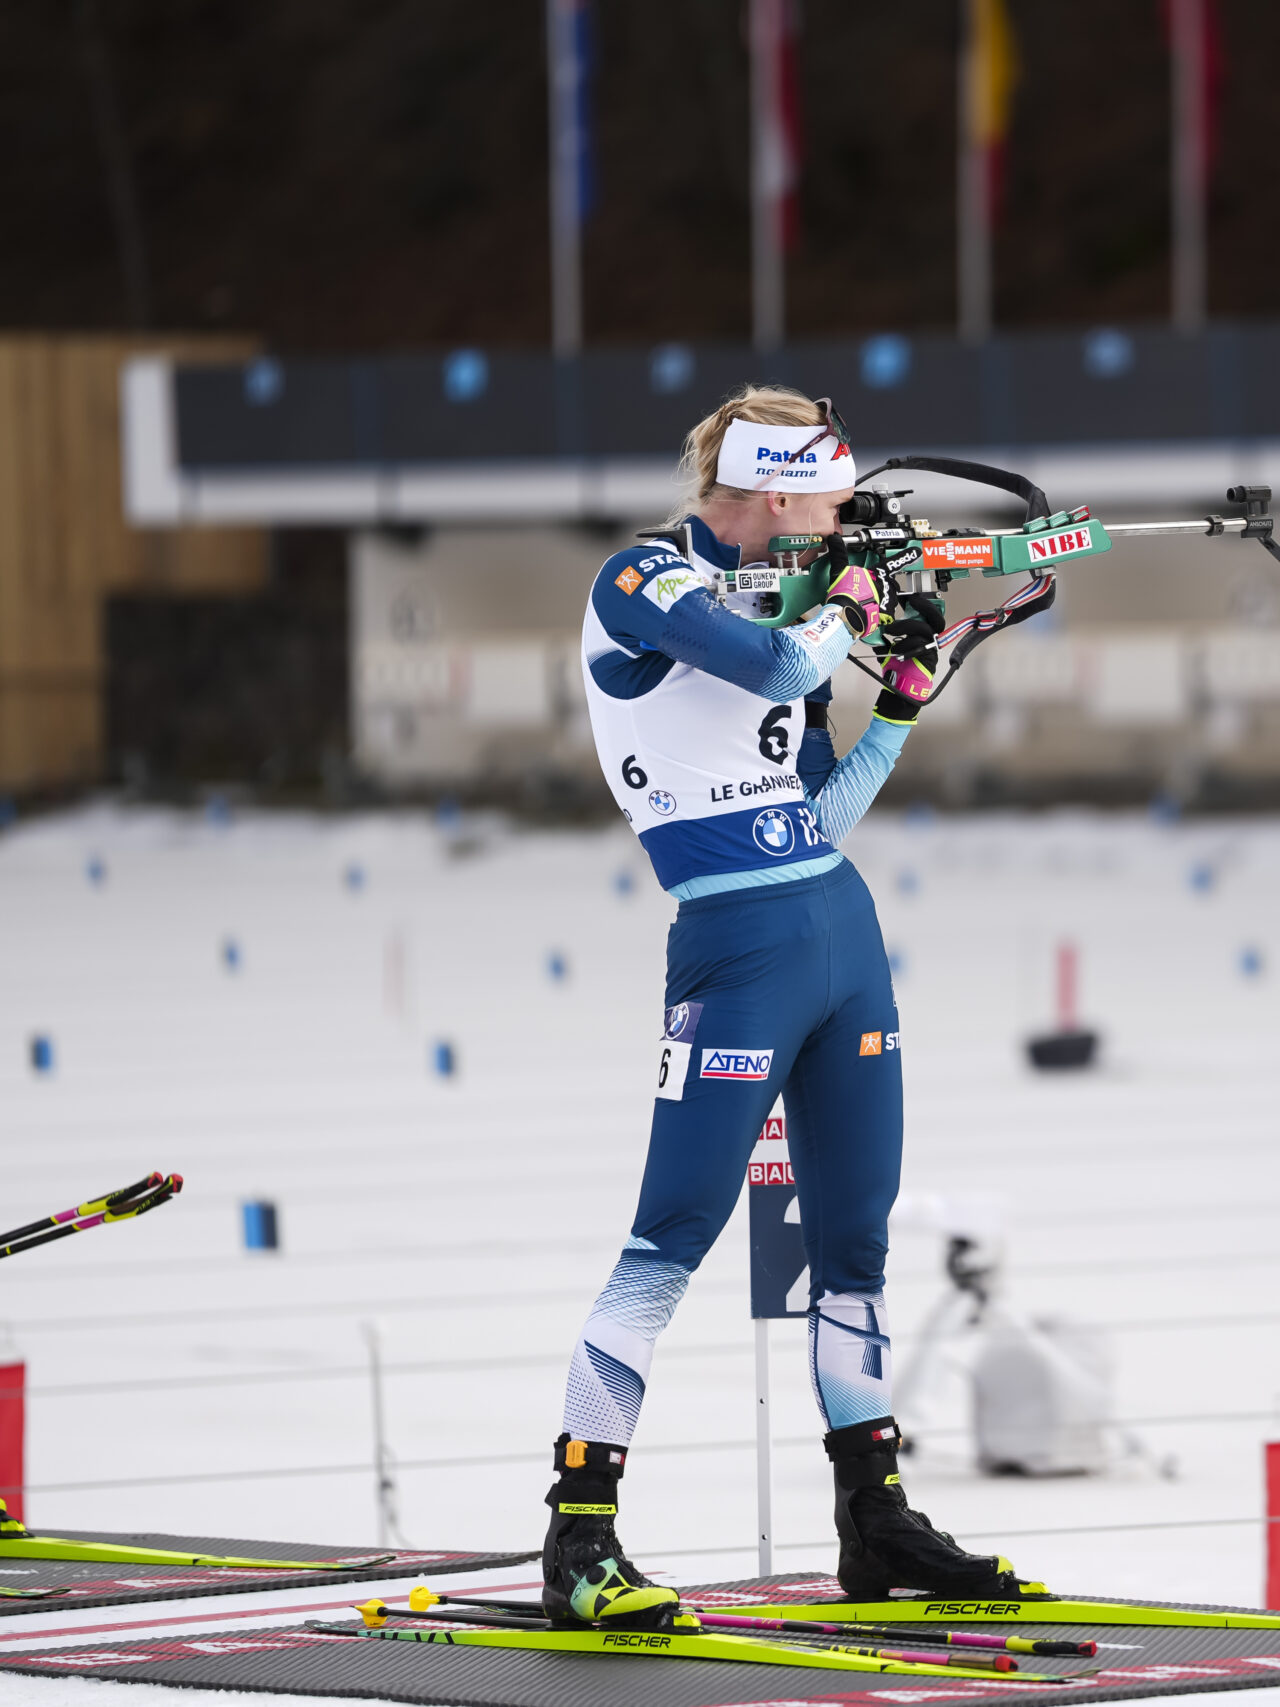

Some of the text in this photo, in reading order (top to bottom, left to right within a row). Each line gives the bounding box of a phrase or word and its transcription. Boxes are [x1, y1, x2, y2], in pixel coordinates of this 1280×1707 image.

[924, 542, 991, 560] VIESSMANN
[1030, 530, 1090, 560] NIBE
[754, 580, 774, 589] GROUP
[757, 704, 792, 765] 6
[621, 754, 648, 789] 6
[711, 784, 734, 802] LE
[658, 1048, 671, 1089] 6
[703, 1051, 770, 1073] ATENO
[924, 1603, 1021, 1615] FISCHER
[603, 1634, 671, 1648] FISCHER
